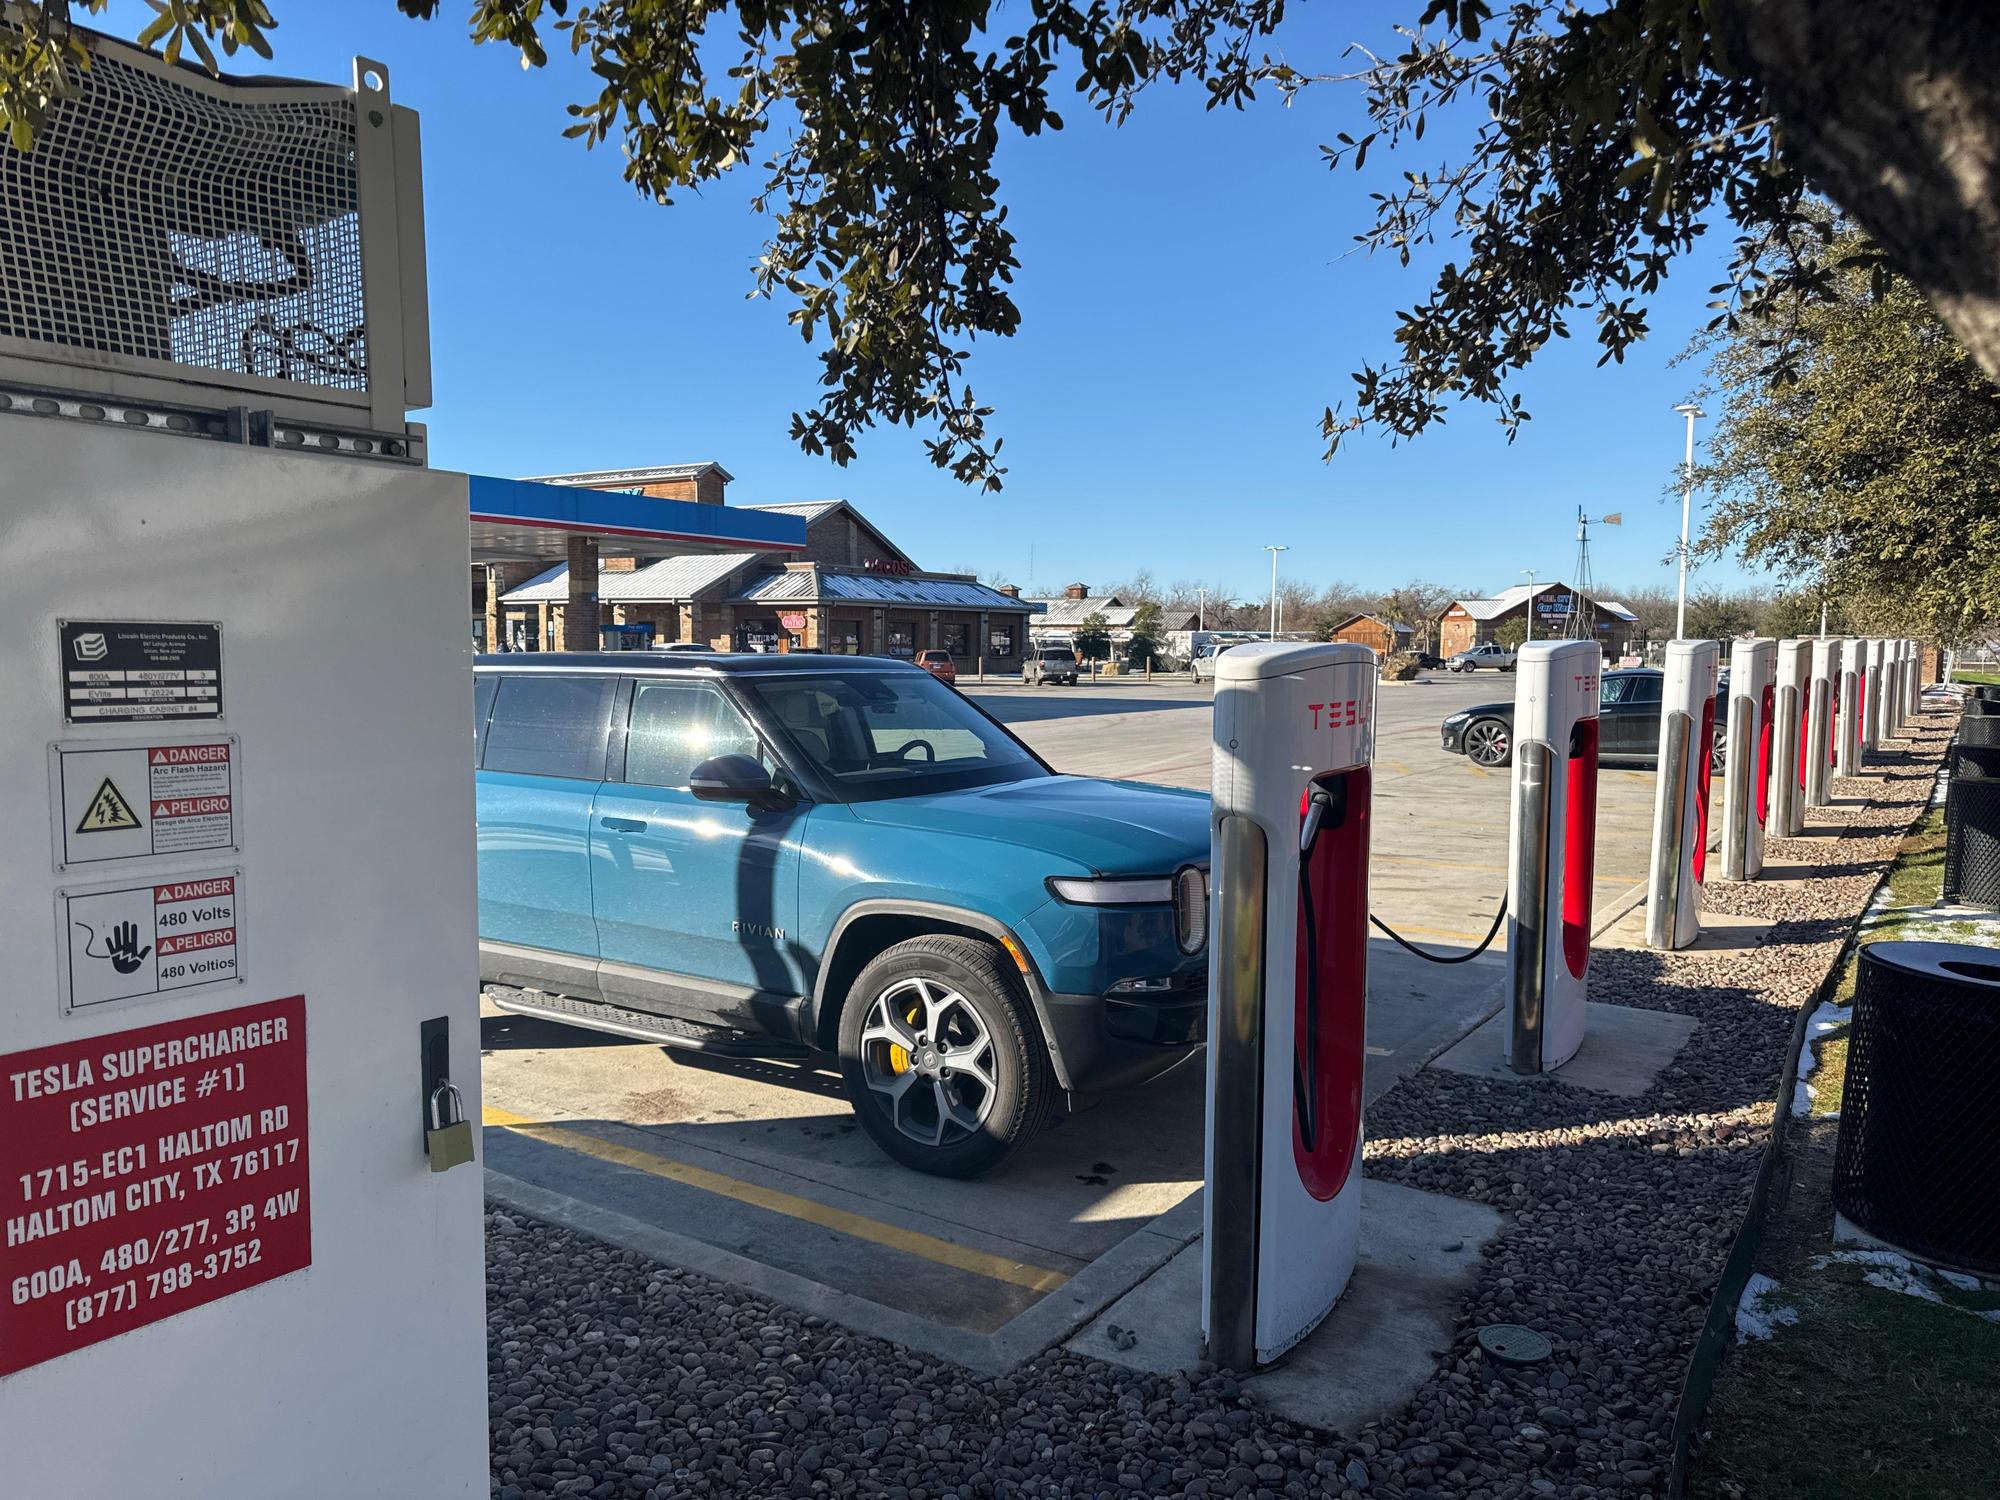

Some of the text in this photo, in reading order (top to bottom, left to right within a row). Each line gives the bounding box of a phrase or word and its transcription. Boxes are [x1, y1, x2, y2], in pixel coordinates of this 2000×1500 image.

[1574, 675, 1597, 692] TES
[99, 705, 146, 716] CHARGING
[149, 704, 185, 714] CABINET
[1308, 700, 1369, 730] TESL
[169, 747, 227, 762] DANGER
[153, 764, 227, 775] Arc Flash Hazard
[171, 798, 229, 814] PELIGRO
[174, 880, 231, 899] DANGER
[159, 907, 231, 927] 480 Volts
[176, 930, 233, 951] PELIGRO
[732, 921, 785, 940] RIVIAN
[160, 959, 235, 979] 480 Voltios
[10, 1017, 289, 1102] TESLA SUPERCHARGER
[19, 1105, 289, 1201] 1715-EC1 HALTOM RD
[7, 1138, 300, 1247] HALTOM CITY, TX 76117
[12, 1188, 300, 1305] 600A, 480/277, 3P, 4W
[146, 1238, 262, 1300] 798-3752
